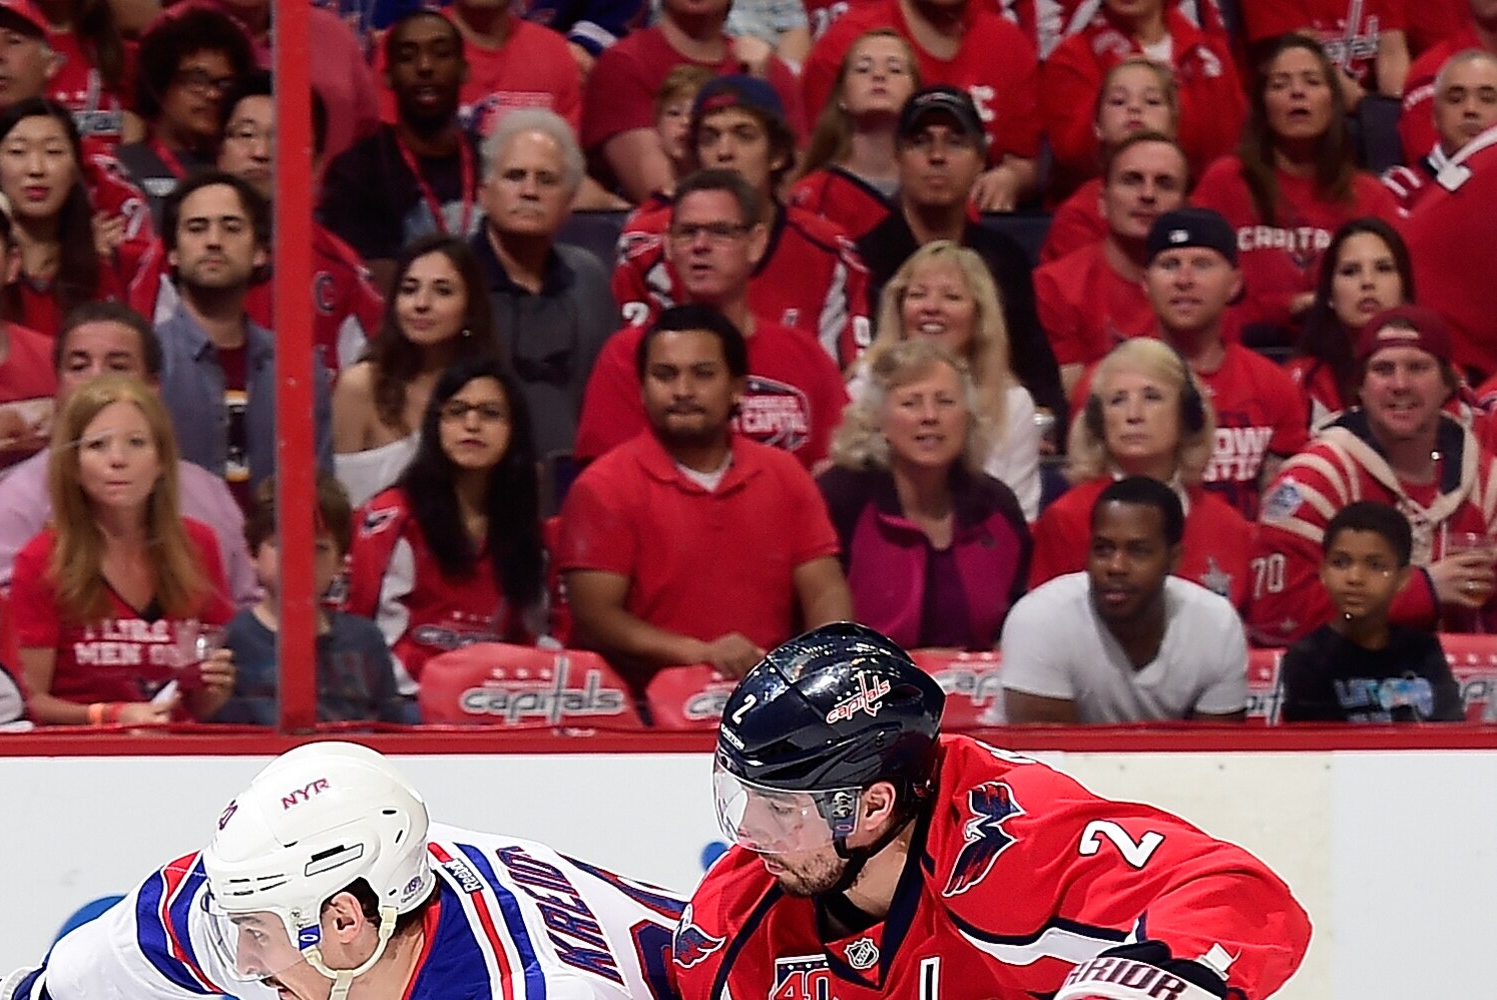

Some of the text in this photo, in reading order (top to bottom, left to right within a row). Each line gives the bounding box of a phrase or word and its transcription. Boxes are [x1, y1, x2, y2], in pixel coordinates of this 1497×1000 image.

[1237, 225, 1331, 252] CAPITA
[458, 654, 627, 725] capitals
[731, 693, 758, 725] 2
[825, 670, 893, 725] capitals
[280, 777, 331, 811] NYR
[1078, 819, 1166, 870] 2
